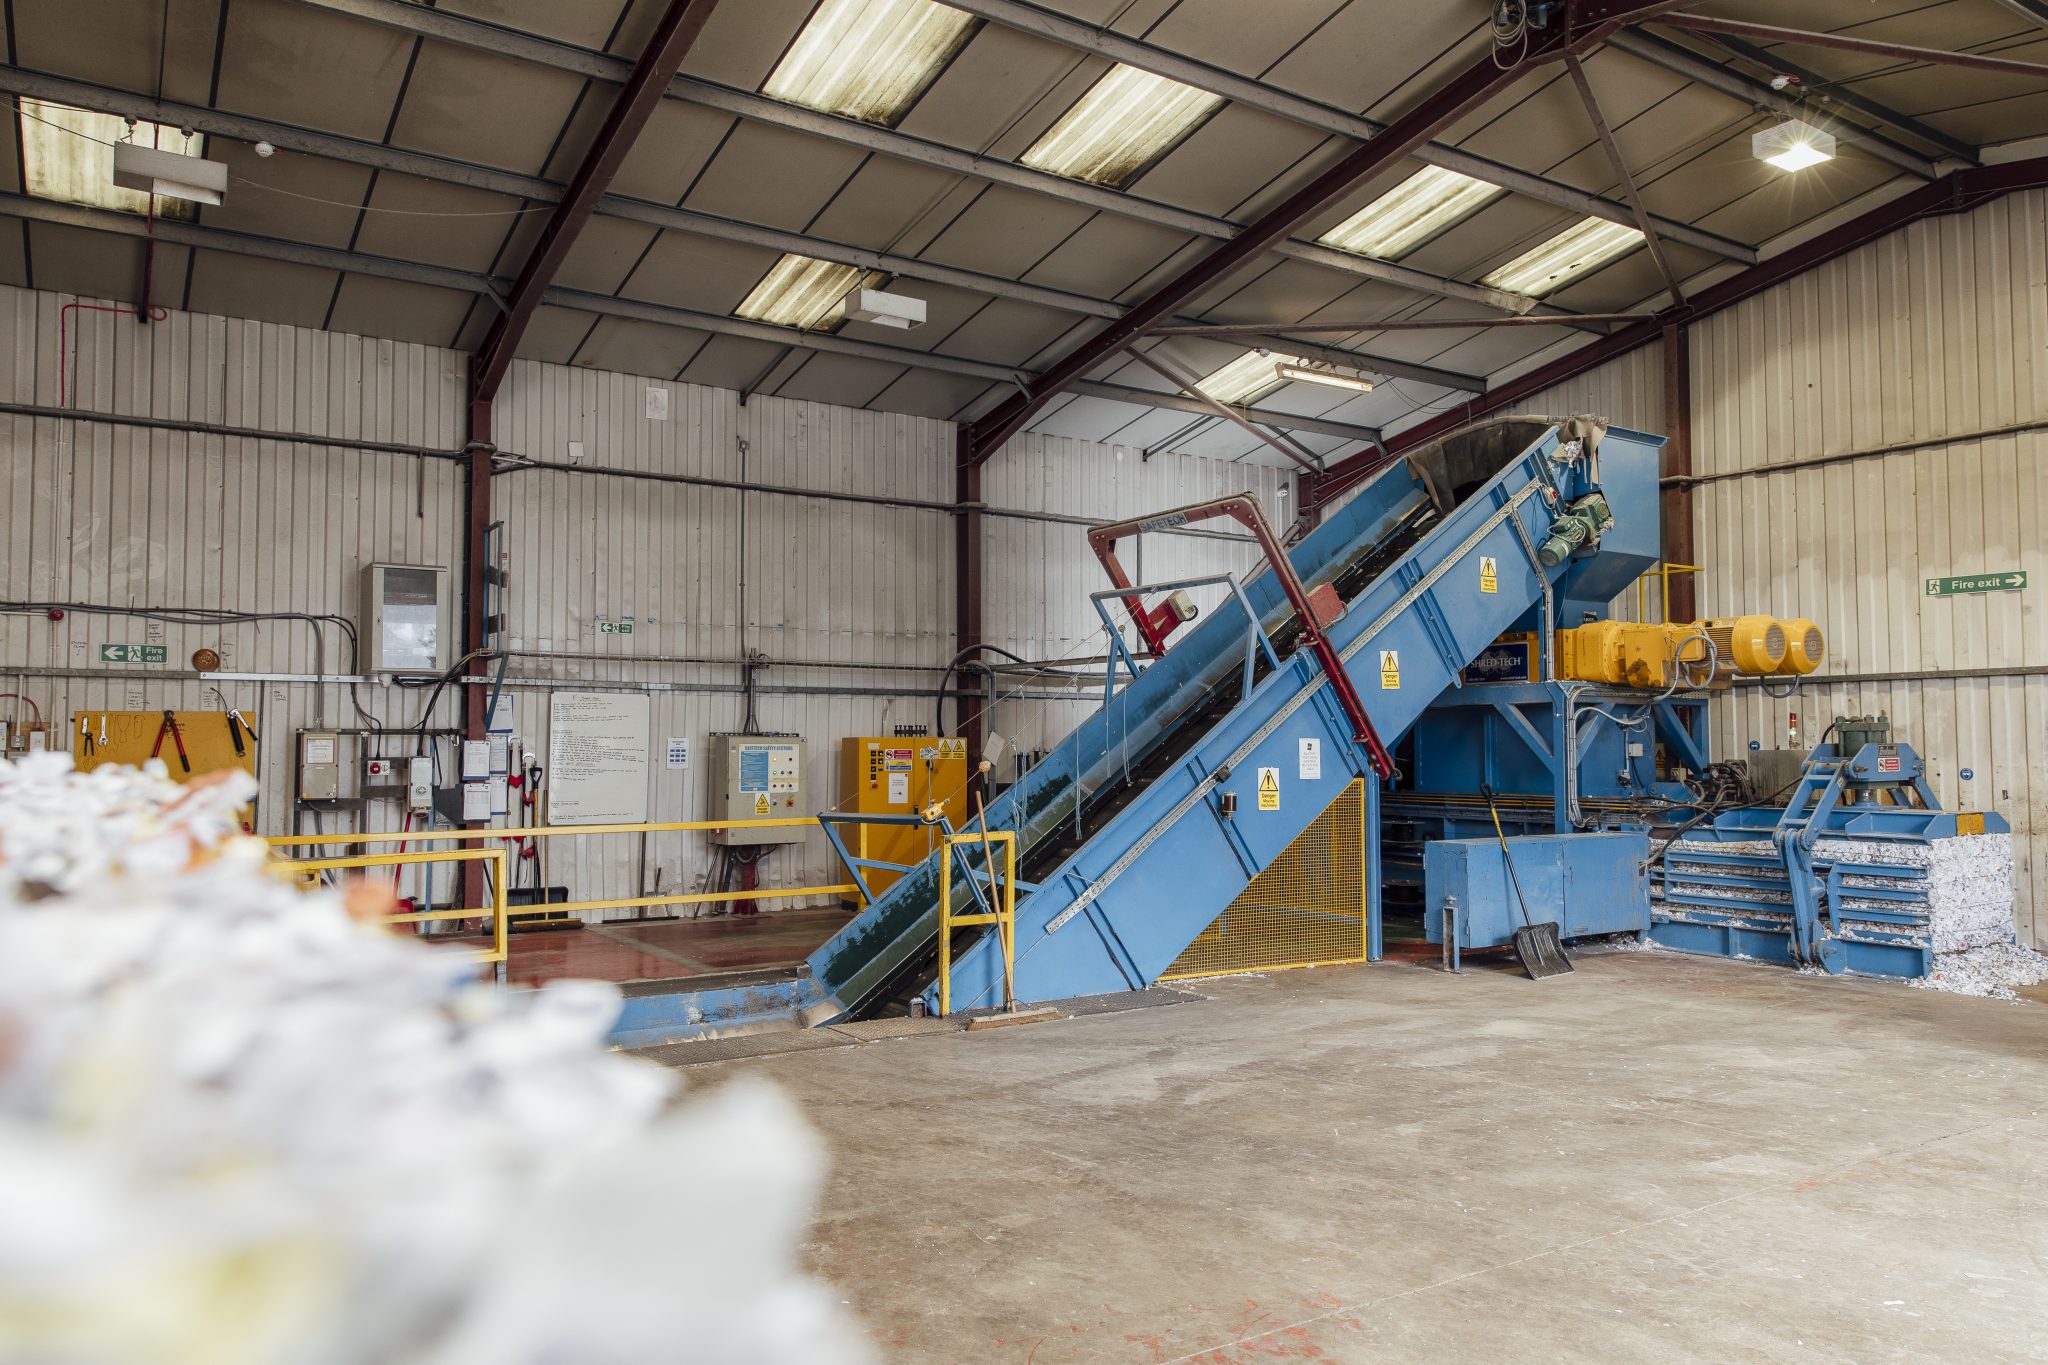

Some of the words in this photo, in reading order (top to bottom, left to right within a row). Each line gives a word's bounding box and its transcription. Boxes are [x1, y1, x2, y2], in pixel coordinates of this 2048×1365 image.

[1140, 515, 1186, 531] SAFETECH
[1952, 580, 1975, 589] Fire
[1978, 578, 2000, 588] exit
